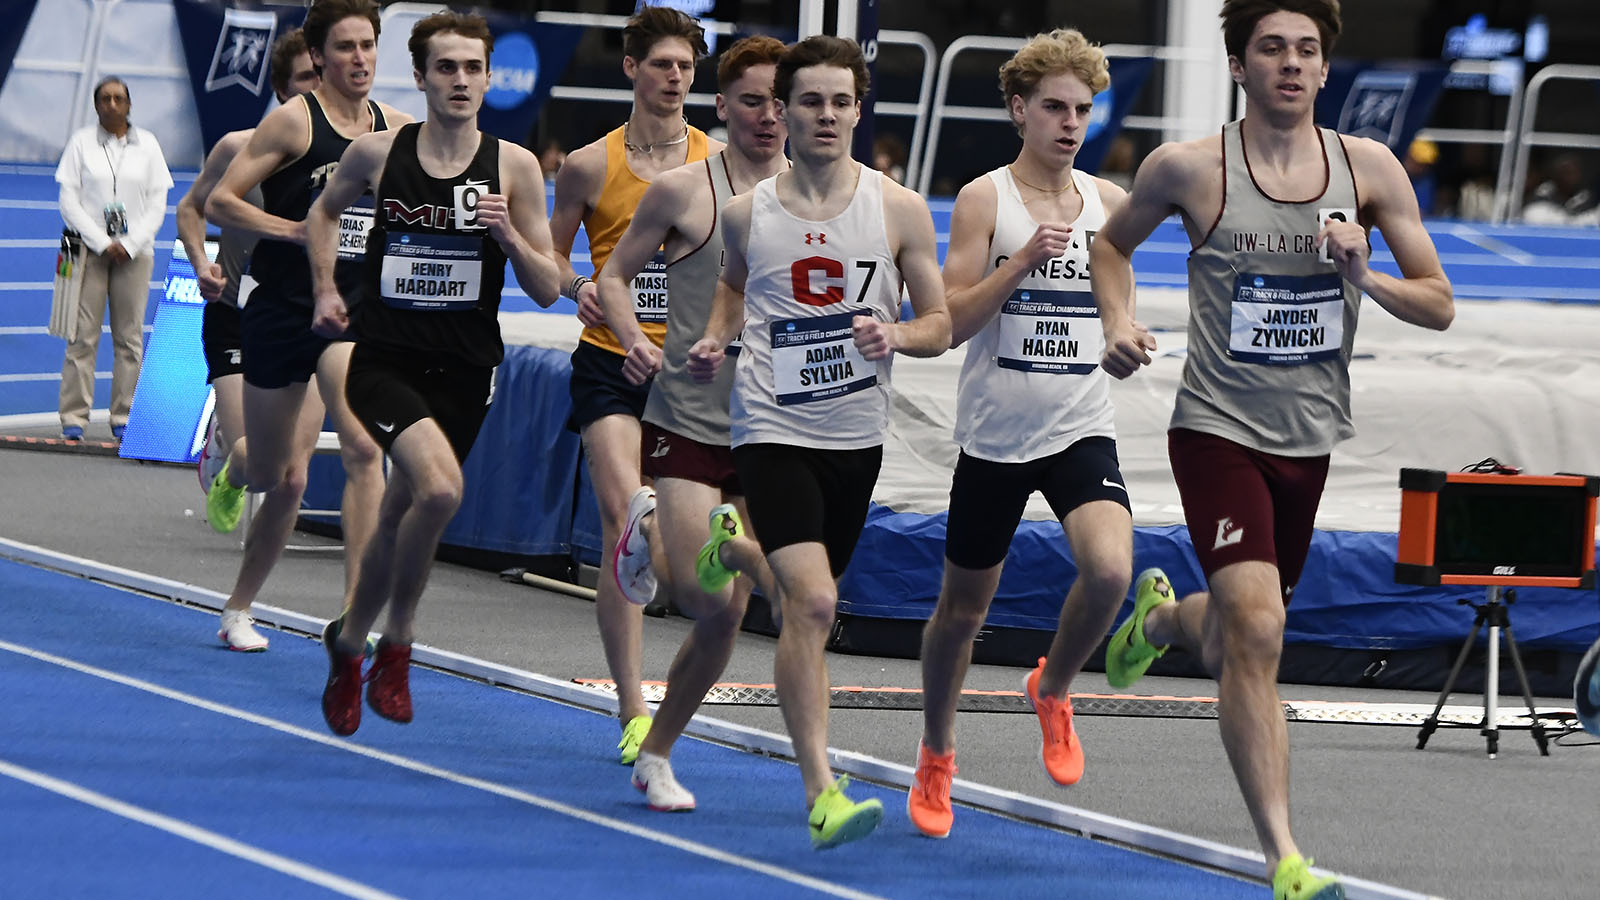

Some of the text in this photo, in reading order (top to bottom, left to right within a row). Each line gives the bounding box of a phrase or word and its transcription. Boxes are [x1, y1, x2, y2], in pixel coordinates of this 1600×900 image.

[384, 198, 456, 230] MI
[462, 187, 480, 227] 9
[1234, 233, 1287, 253] UW-LA
[1294, 234, 1320, 254] CR
[411, 262, 453, 277] HENRY
[395, 278, 467, 297] HARDART
[634, 276, 669, 290] MASO
[791, 256, 844, 307] C
[856, 261, 877, 302] 7
[637, 292, 669, 308] SHE
[1020, 304, 1038, 312] TRACK
[1056, 305, 1098, 314] CHAMPIONSHIPS
[1262, 308, 1318, 325] JAYDEN
[787, 334, 804, 343] TRACK
[809, 331, 825, 340] FIELD
[826, 327, 853, 338] CHAMPIO
[1035, 321, 1070, 336] RYAN
[1251, 327, 1325, 348] ZYWICKI
[805, 344, 845, 364] ADAM
[1022, 338, 1079, 358] HAGAN
[800, 360, 854, 387] SYLVIA
